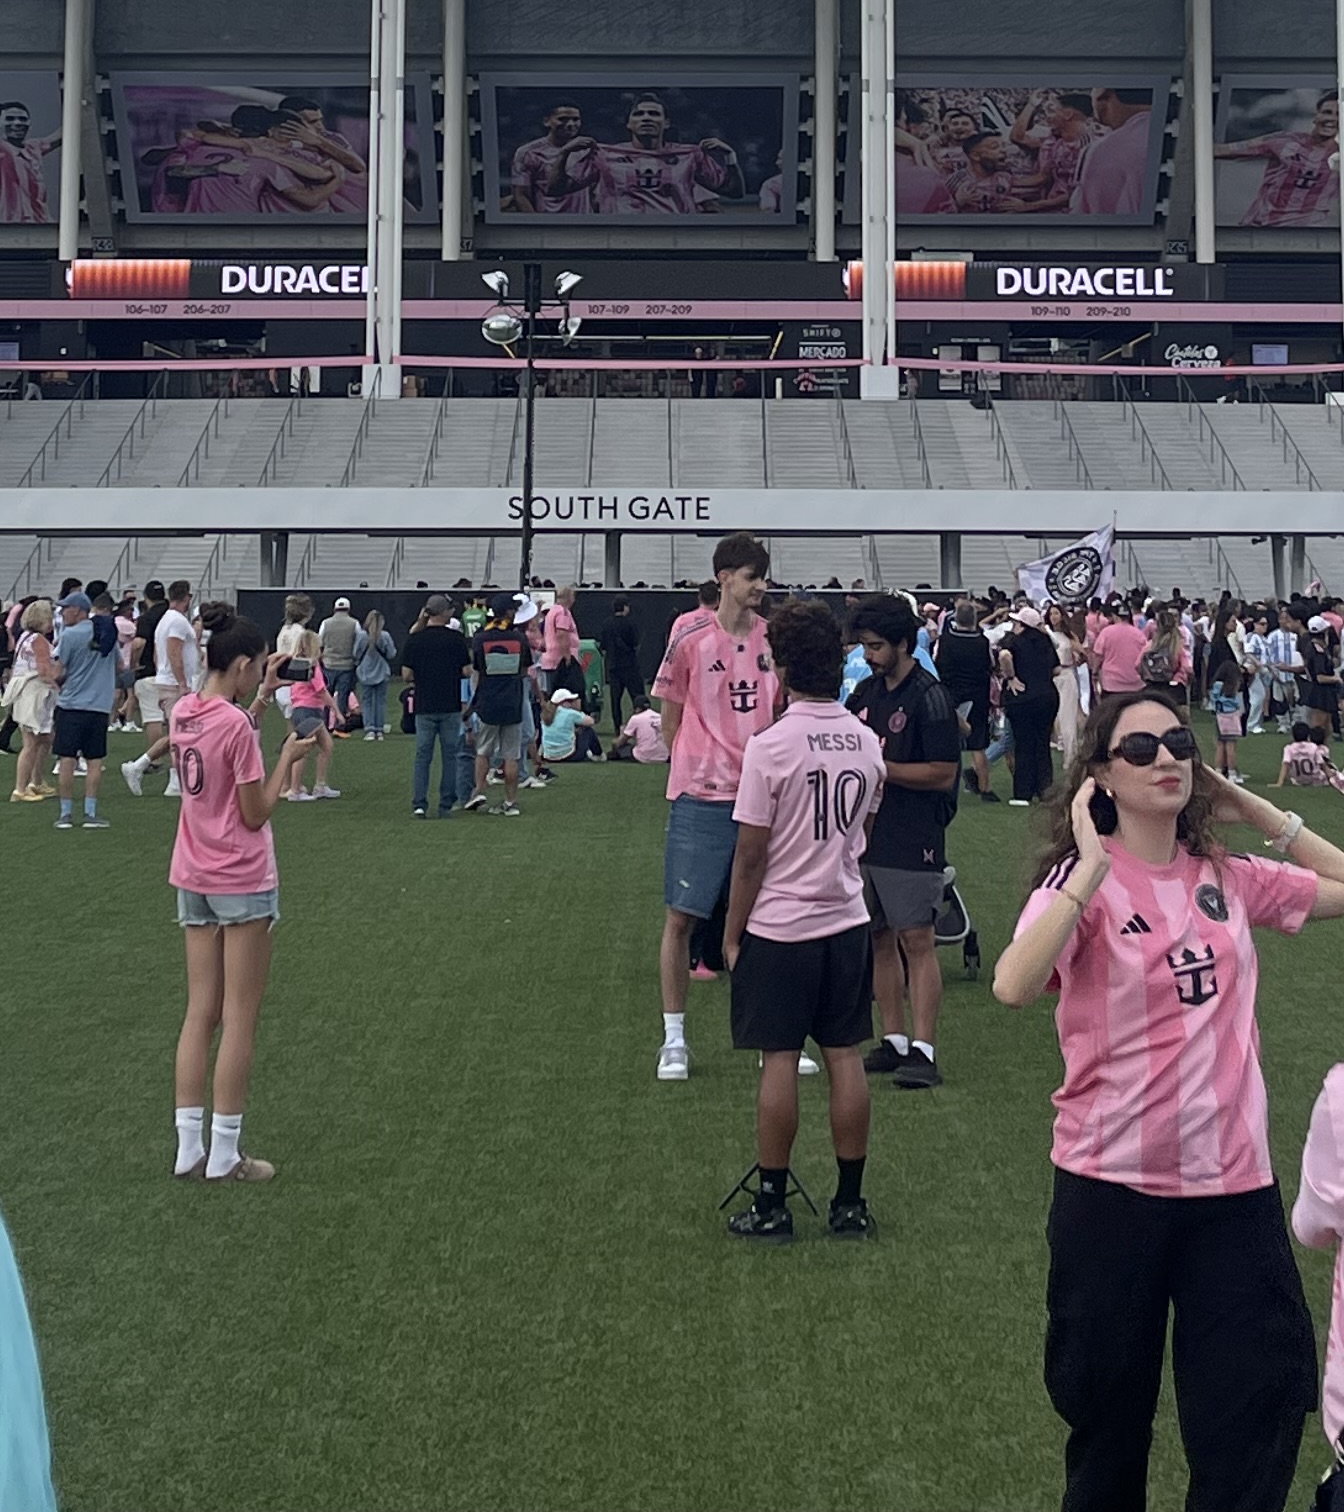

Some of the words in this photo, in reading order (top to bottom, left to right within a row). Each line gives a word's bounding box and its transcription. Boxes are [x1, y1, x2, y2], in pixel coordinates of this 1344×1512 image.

[222, 265, 379, 294] DURACEL
[997, 267, 1174, 297] DURACELL
[508, 495, 618, 521] SOUTH
[628, 495, 711, 521] GATE
[807, 732, 863, 752] MESSI
[1291, 758, 1314, 778] 10
[806, 768, 867, 841] 10
